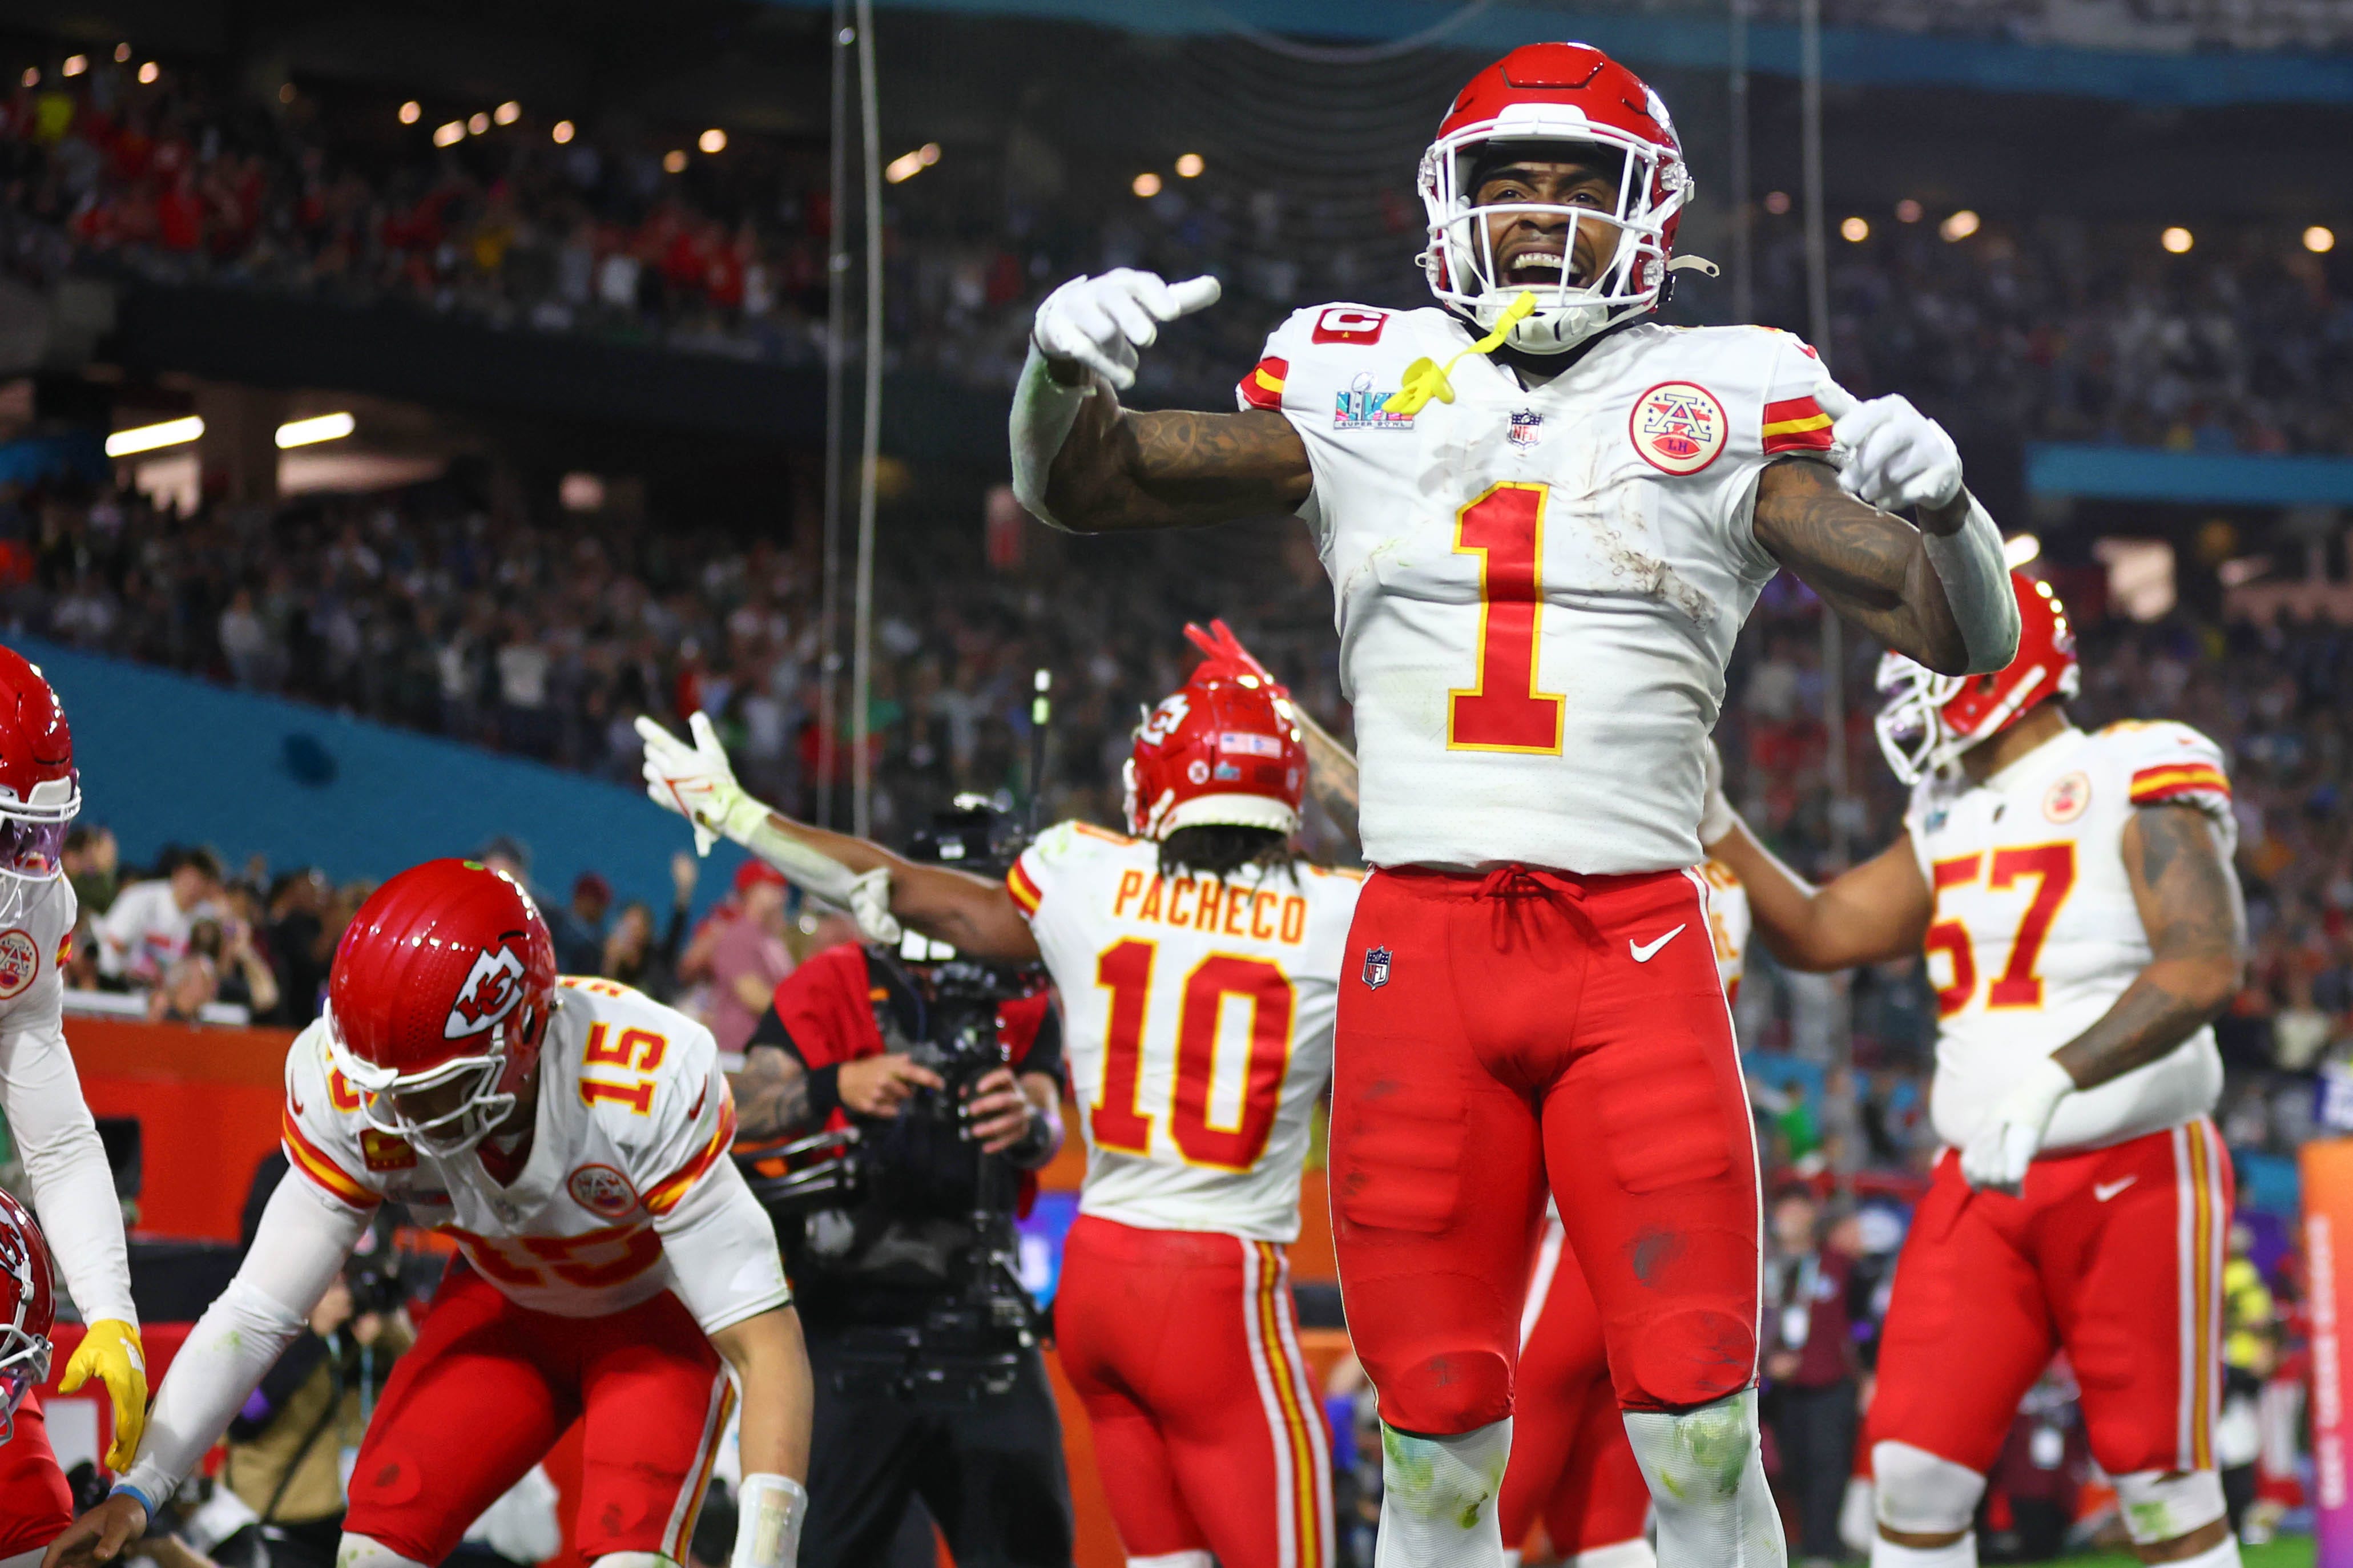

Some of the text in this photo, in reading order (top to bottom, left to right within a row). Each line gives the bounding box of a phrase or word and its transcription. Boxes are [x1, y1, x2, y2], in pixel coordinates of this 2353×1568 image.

[1644, 393, 1711, 442] A
[1667, 439, 1688, 453] LH
[1447, 481, 1566, 756] 1
[1112, 869, 1308, 946] PACHECO
[1924, 839, 2078, 1022] 57
[578, 1019, 670, 1119] 15
[1090, 935, 1298, 1175] 10
